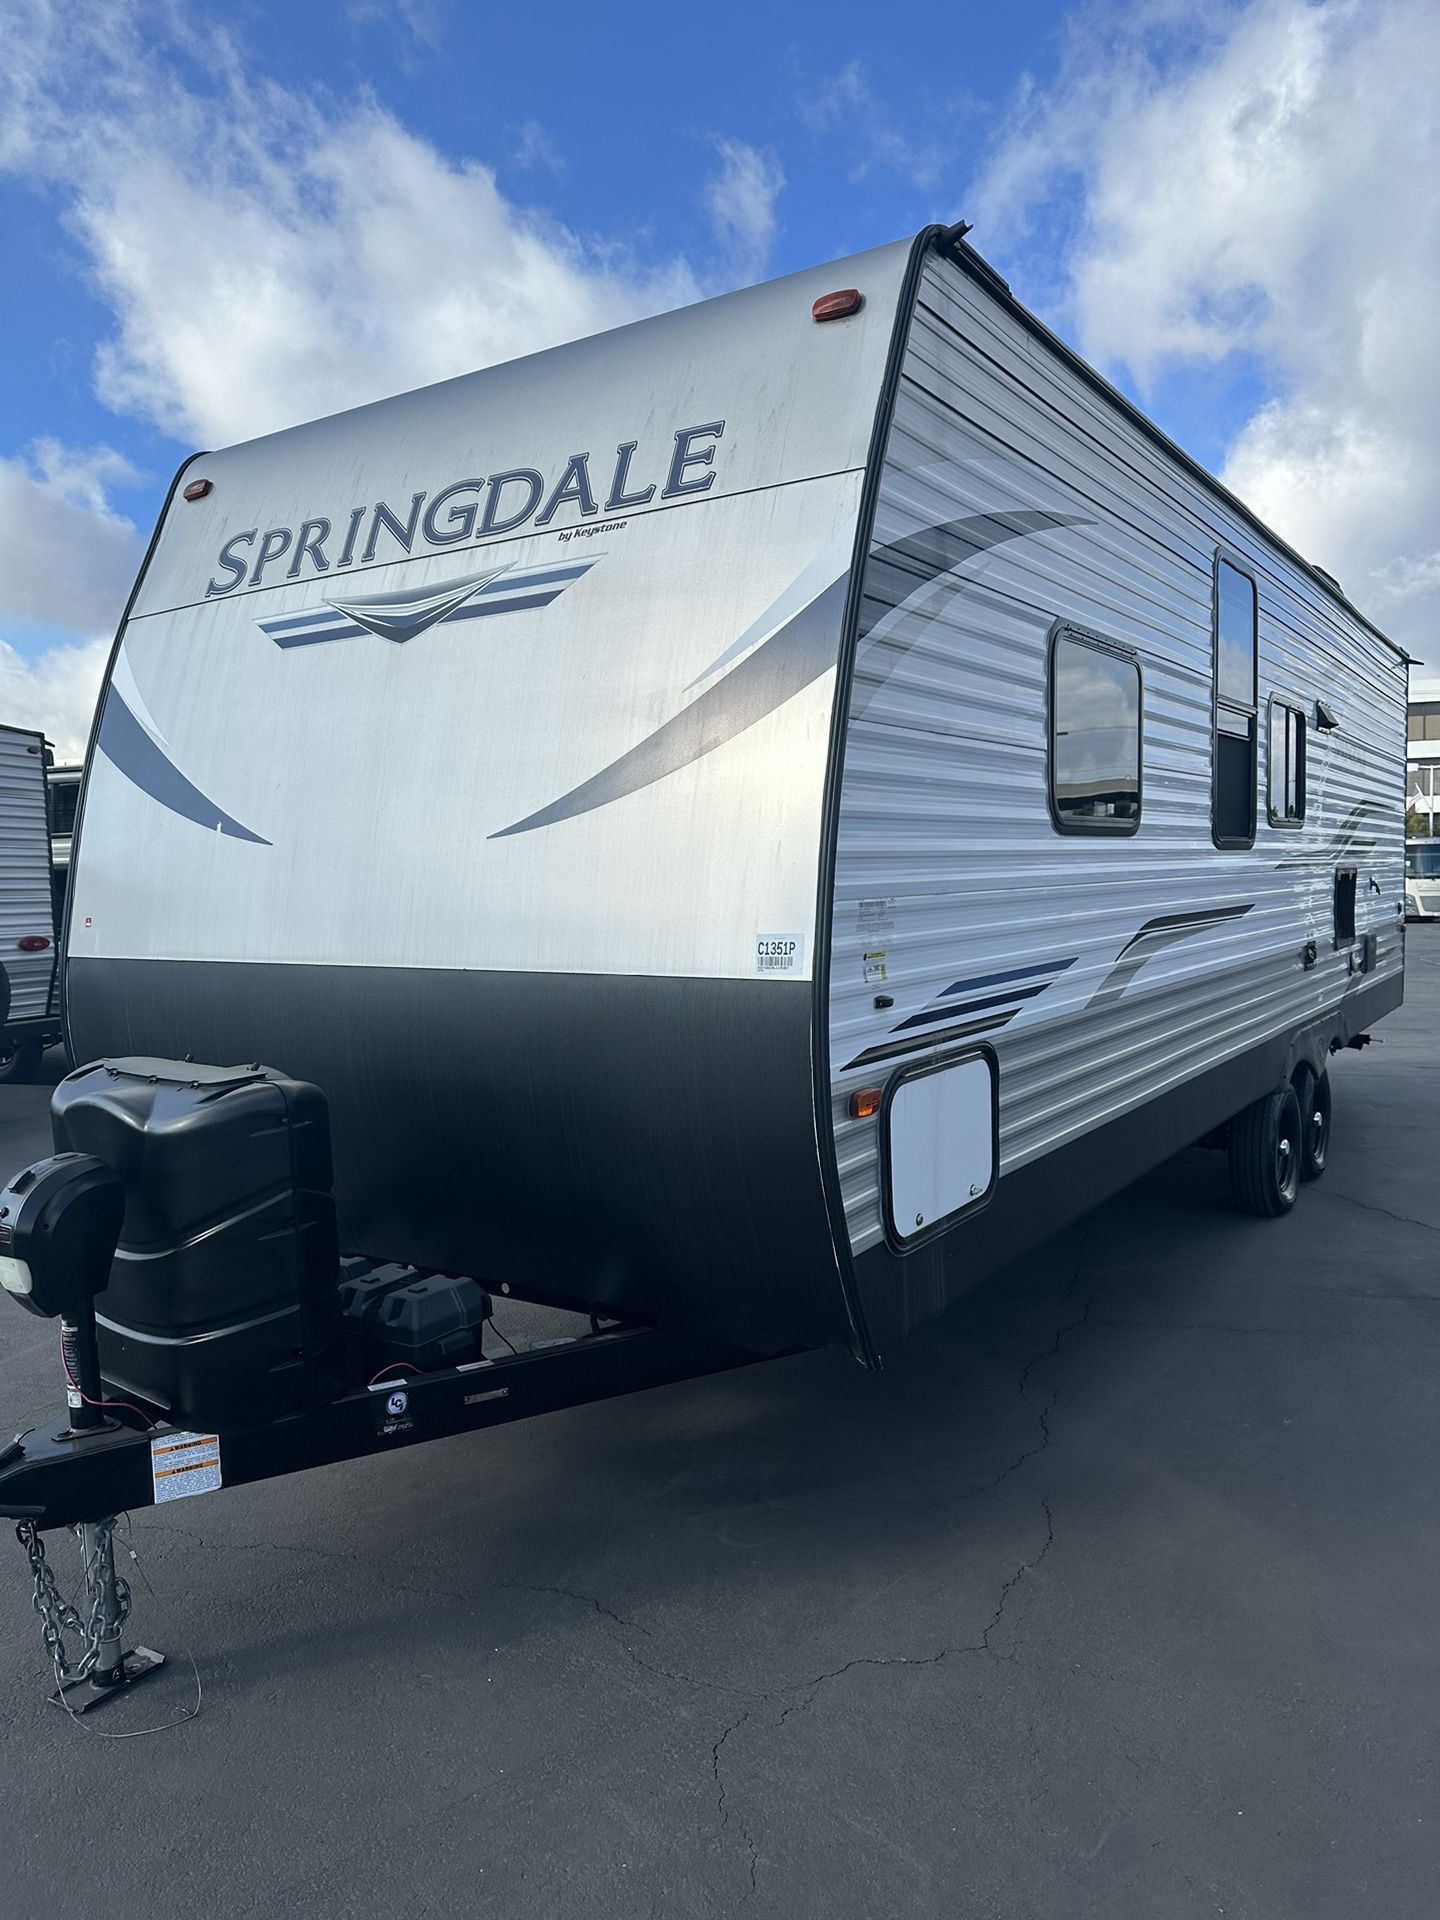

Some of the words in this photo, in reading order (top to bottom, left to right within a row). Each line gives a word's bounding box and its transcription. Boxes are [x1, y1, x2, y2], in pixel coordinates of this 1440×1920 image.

[205, 419, 726, 598] SPRINGDALE
[558, 532, 572, 543] by
[573, 521, 627, 538] Keystone
[757, 941, 796, 956] C1351P
[174, 1440, 202, 1450] WARNING
